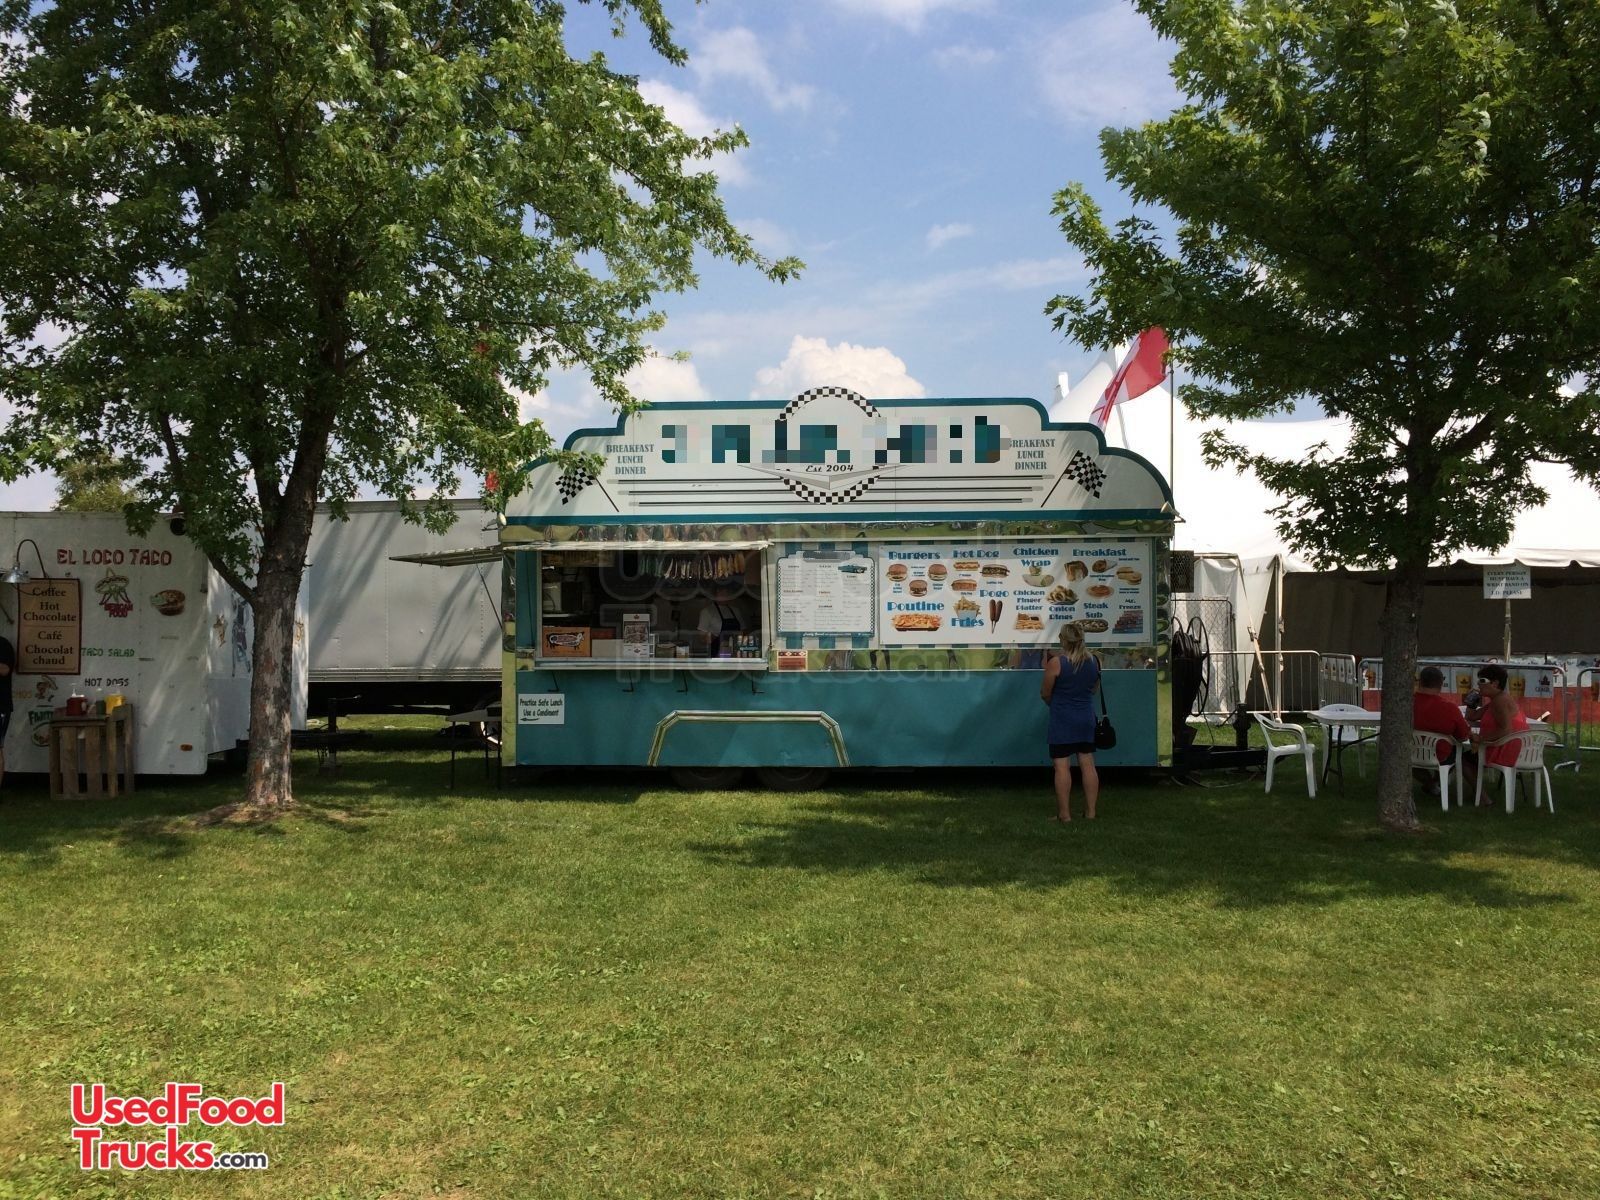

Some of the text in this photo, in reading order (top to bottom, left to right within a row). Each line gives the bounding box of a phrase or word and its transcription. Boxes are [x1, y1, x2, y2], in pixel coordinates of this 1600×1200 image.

[1009, 439, 1055, 448] REAKFAST
[606, 444, 654, 453] BREAKFAST
[1017, 450, 1044, 459] LUNCH
[617, 455, 644, 464] LUNCH
[826, 464, 854, 472] 2004
[1015, 461, 1047, 470] DINNER
[615, 466, 646, 475] DINNER
[888, 551, 941, 560] Burgers
[953, 550, 1000, 558] Hot Dog
[1013, 547, 1059, 556] Chicken
[1072, 548, 1127, 557] Breakfast
[57, 549, 172, 565] EL LOCO TACO
[1021, 559, 1051, 567] Wrap
[32, 586, 66, 597] Coffee
[979, 589, 1009, 598] Pogo
[40, 601, 60, 611] Hot
[887, 601, 945, 611] Poutine
[23, 612, 77, 622] Chocolate
[951, 617, 984, 627] Fries
[38, 630, 63, 640] Café
[25, 645, 73, 655] Chocolat
[81, 647, 135, 657] TACO SALAD
[32, 655, 65, 665] chaud
[85, 678, 129, 687] HOT DOGS
[519, 698, 563, 707] Practice Safe Lunch
[523, 709, 532, 717] Use
[537, 709, 559, 717] Condiment
